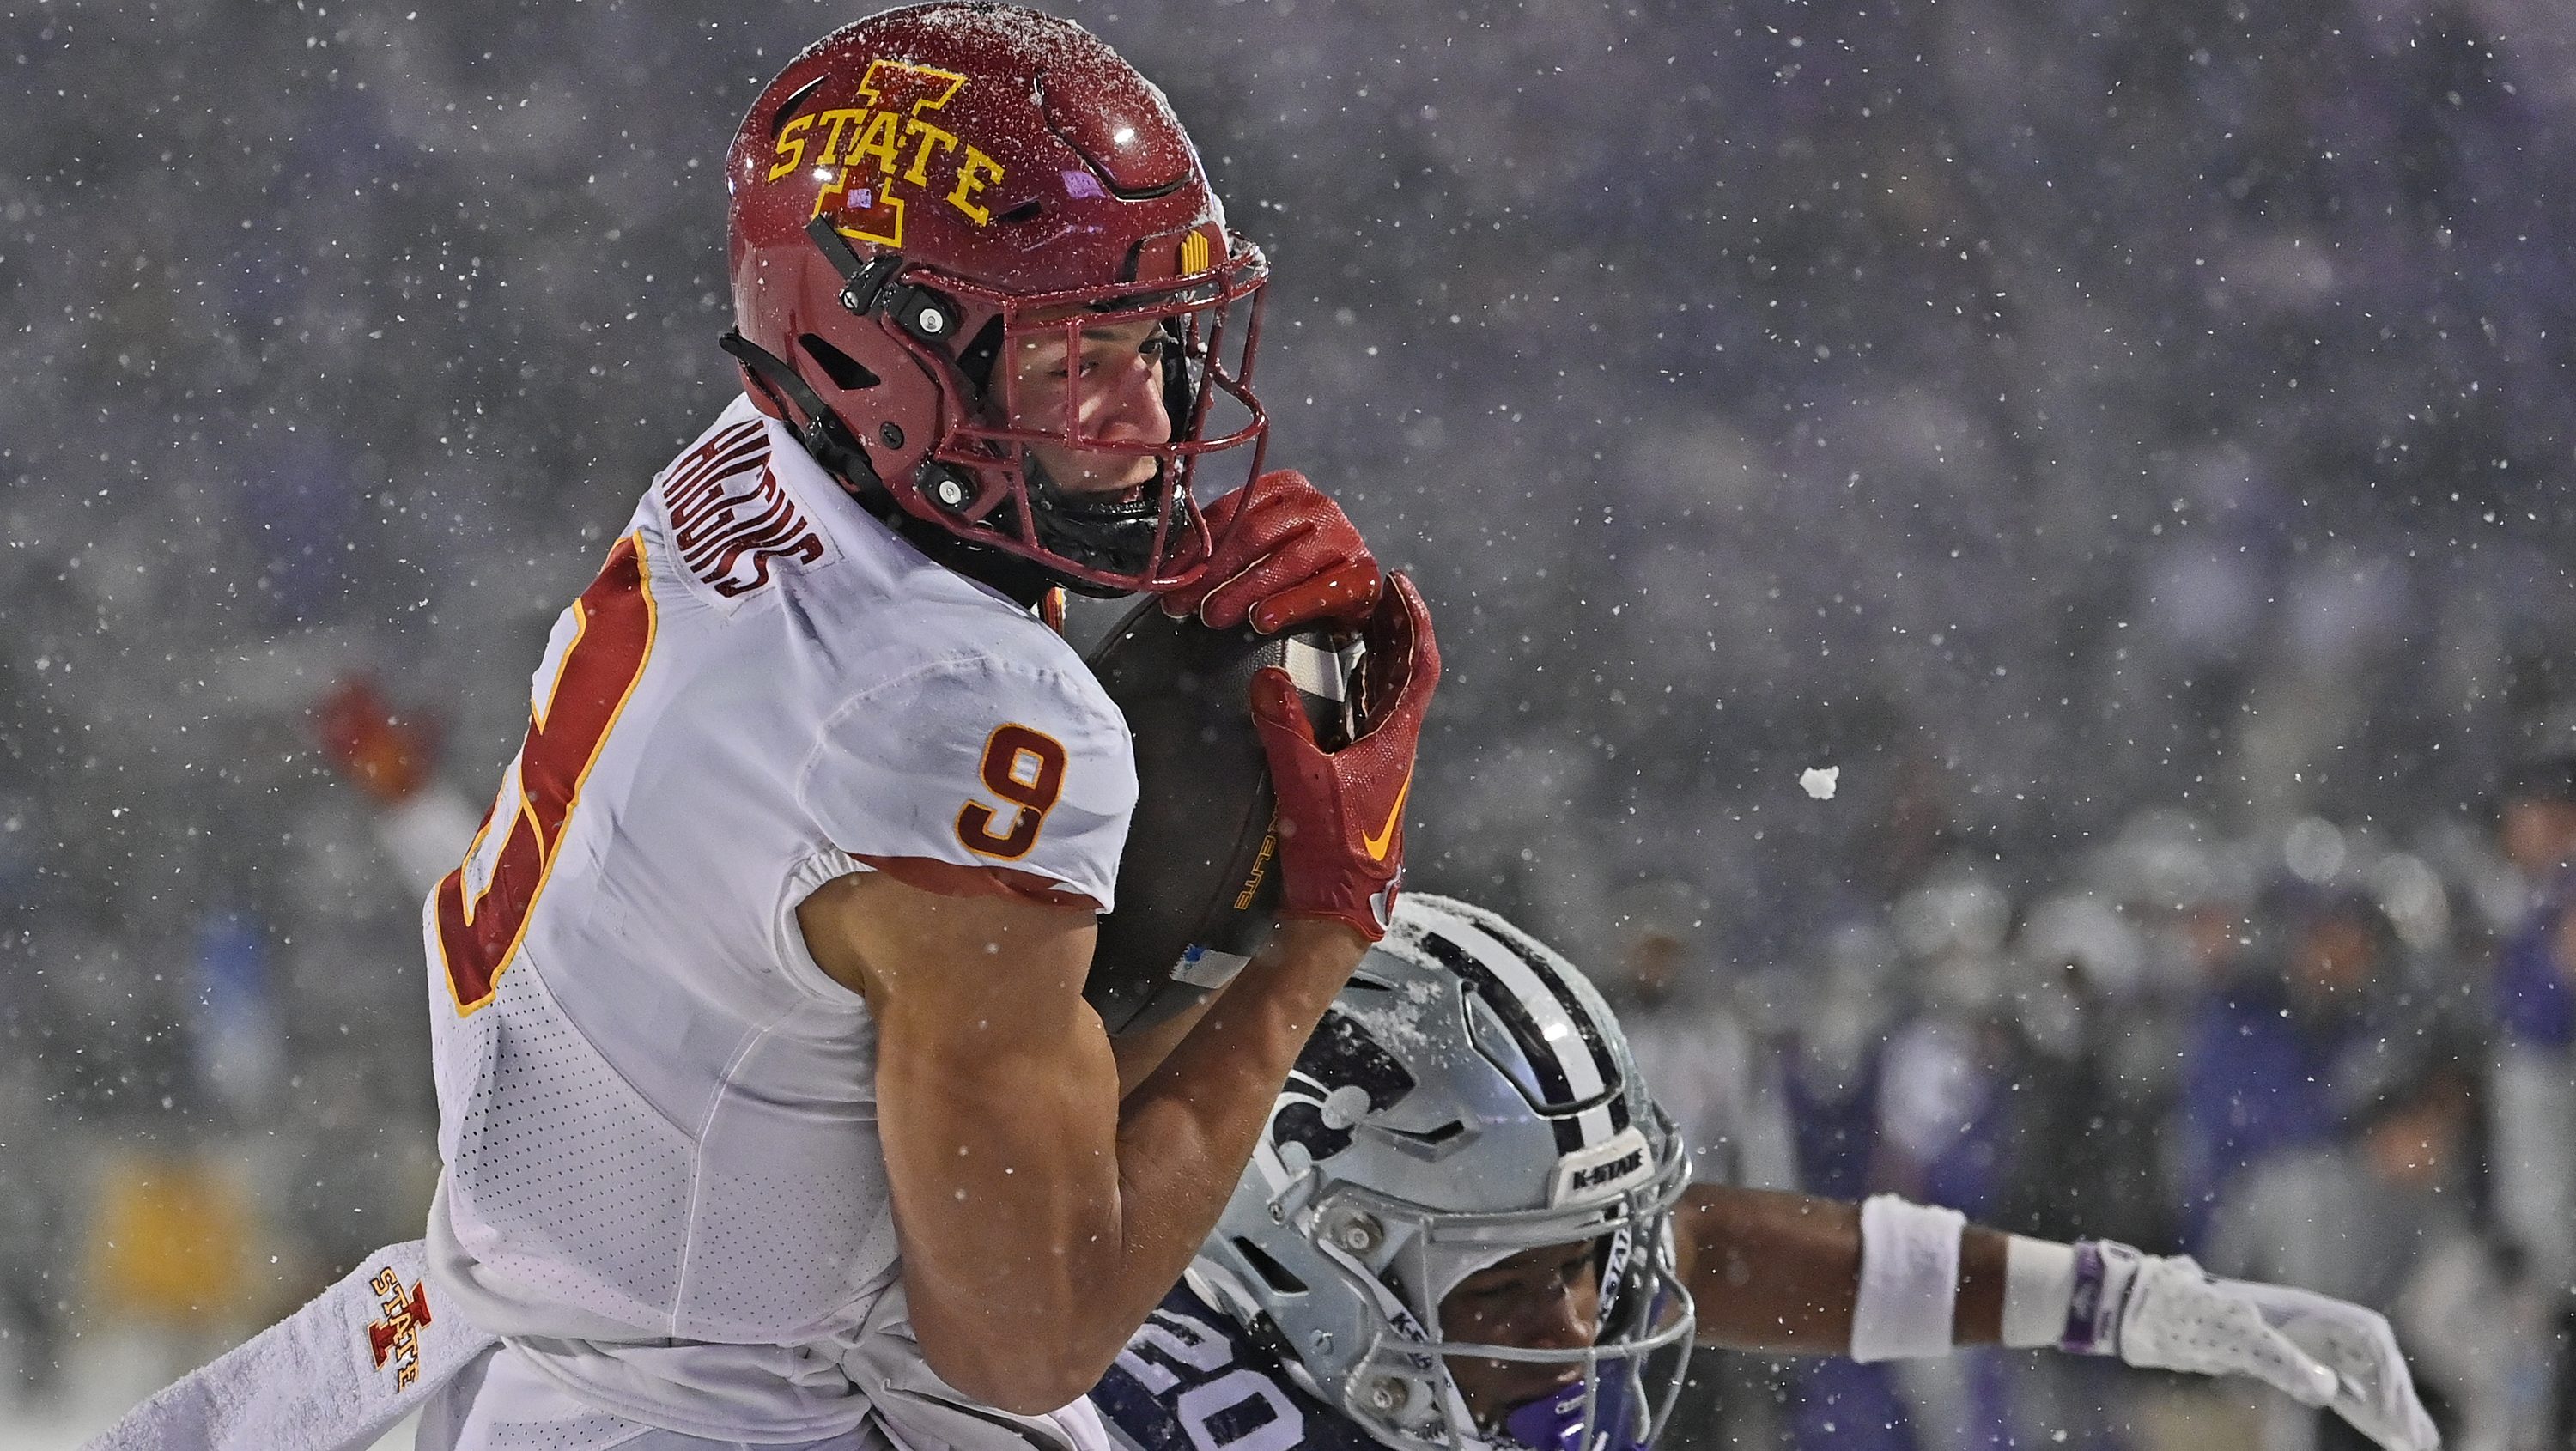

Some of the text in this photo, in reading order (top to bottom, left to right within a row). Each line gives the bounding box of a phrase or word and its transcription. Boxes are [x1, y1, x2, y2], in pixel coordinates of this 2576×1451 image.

[768, 107, 1005, 227] STATE
[661, 416, 824, 598] HIGGINS
[953, 721, 1071, 862] 9
[370, 1266, 420, 1393] STATE
[1115, 1308, 1307, 1451] 20
